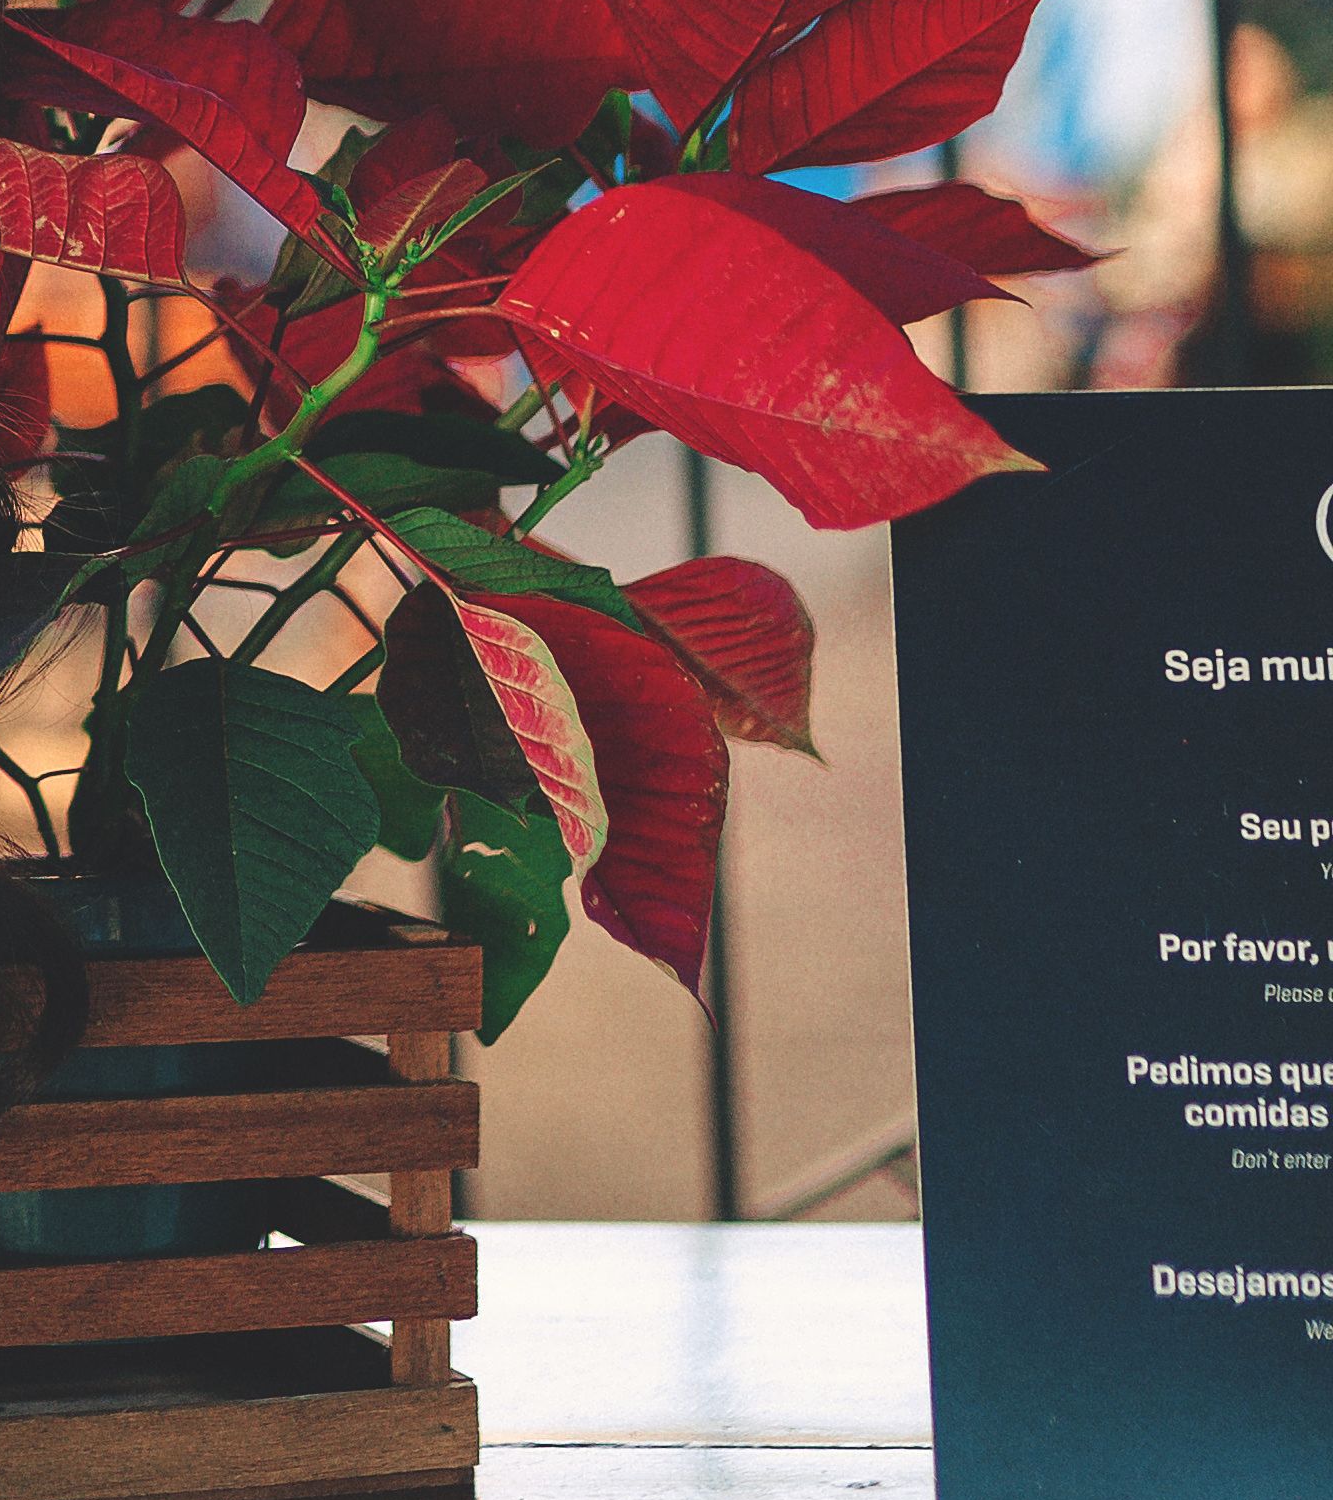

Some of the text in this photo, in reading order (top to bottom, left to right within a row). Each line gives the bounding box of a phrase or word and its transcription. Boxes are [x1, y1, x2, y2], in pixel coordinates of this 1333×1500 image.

[1164, 648, 1251, 691] Seja
[1240, 812, 1302, 841] Seu
[1159, 932, 1217, 962] Por
[1222, 931, 1320, 966] favor,
[1264, 983, 1324, 1003] Please
[1126, 1054, 1273, 1086] Pedimos
[1184, 1096, 1330, 1128] comidas
[1232, 1148, 1332, 1170] Don't enter
[1152, 1263, 1333, 1304] Desejamos
